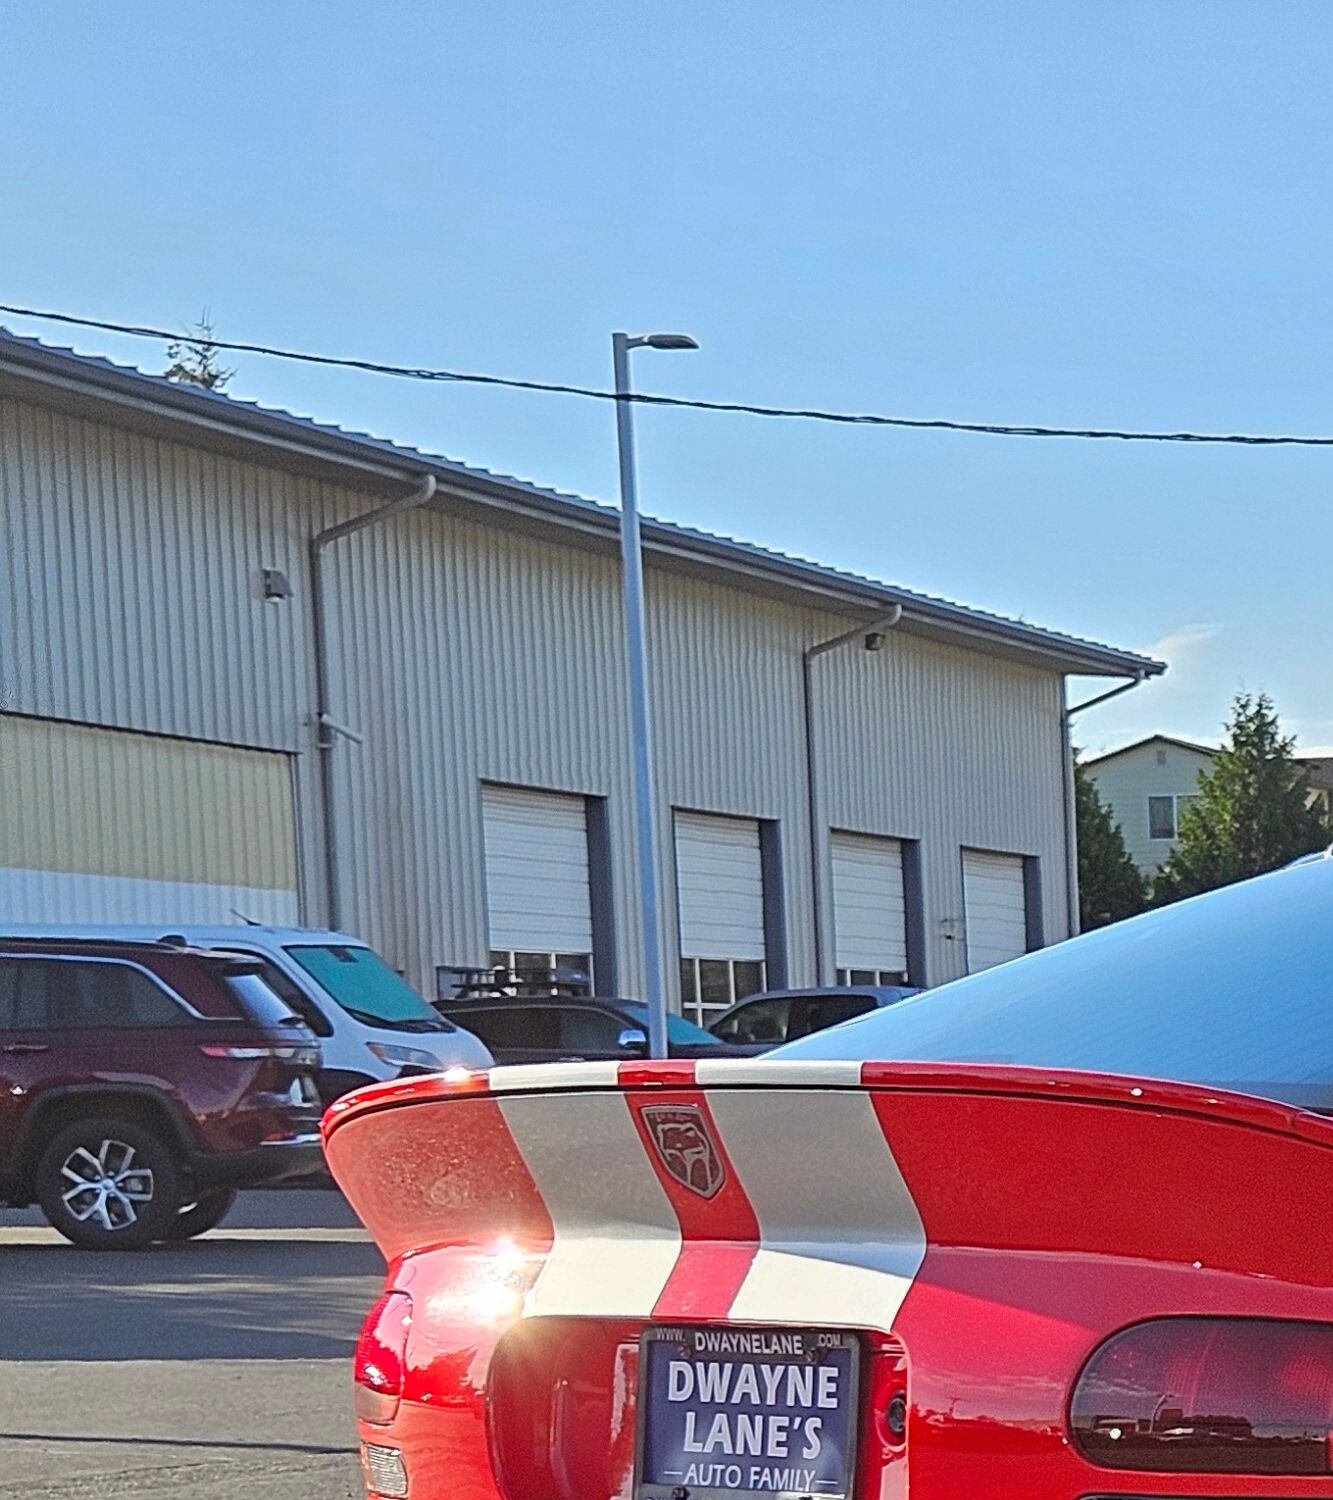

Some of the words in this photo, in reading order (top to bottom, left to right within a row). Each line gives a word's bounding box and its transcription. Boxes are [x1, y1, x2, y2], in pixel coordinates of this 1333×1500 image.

[694, 1332, 803, 1355] DWAYNELANE
[668, 1361, 839, 1409] DWAYNE
[683, 1411, 823, 1459] LANE'S
[682, 1463, 742, 1486] AUTO
[749, 1466, 816, 1492] FAMILY
